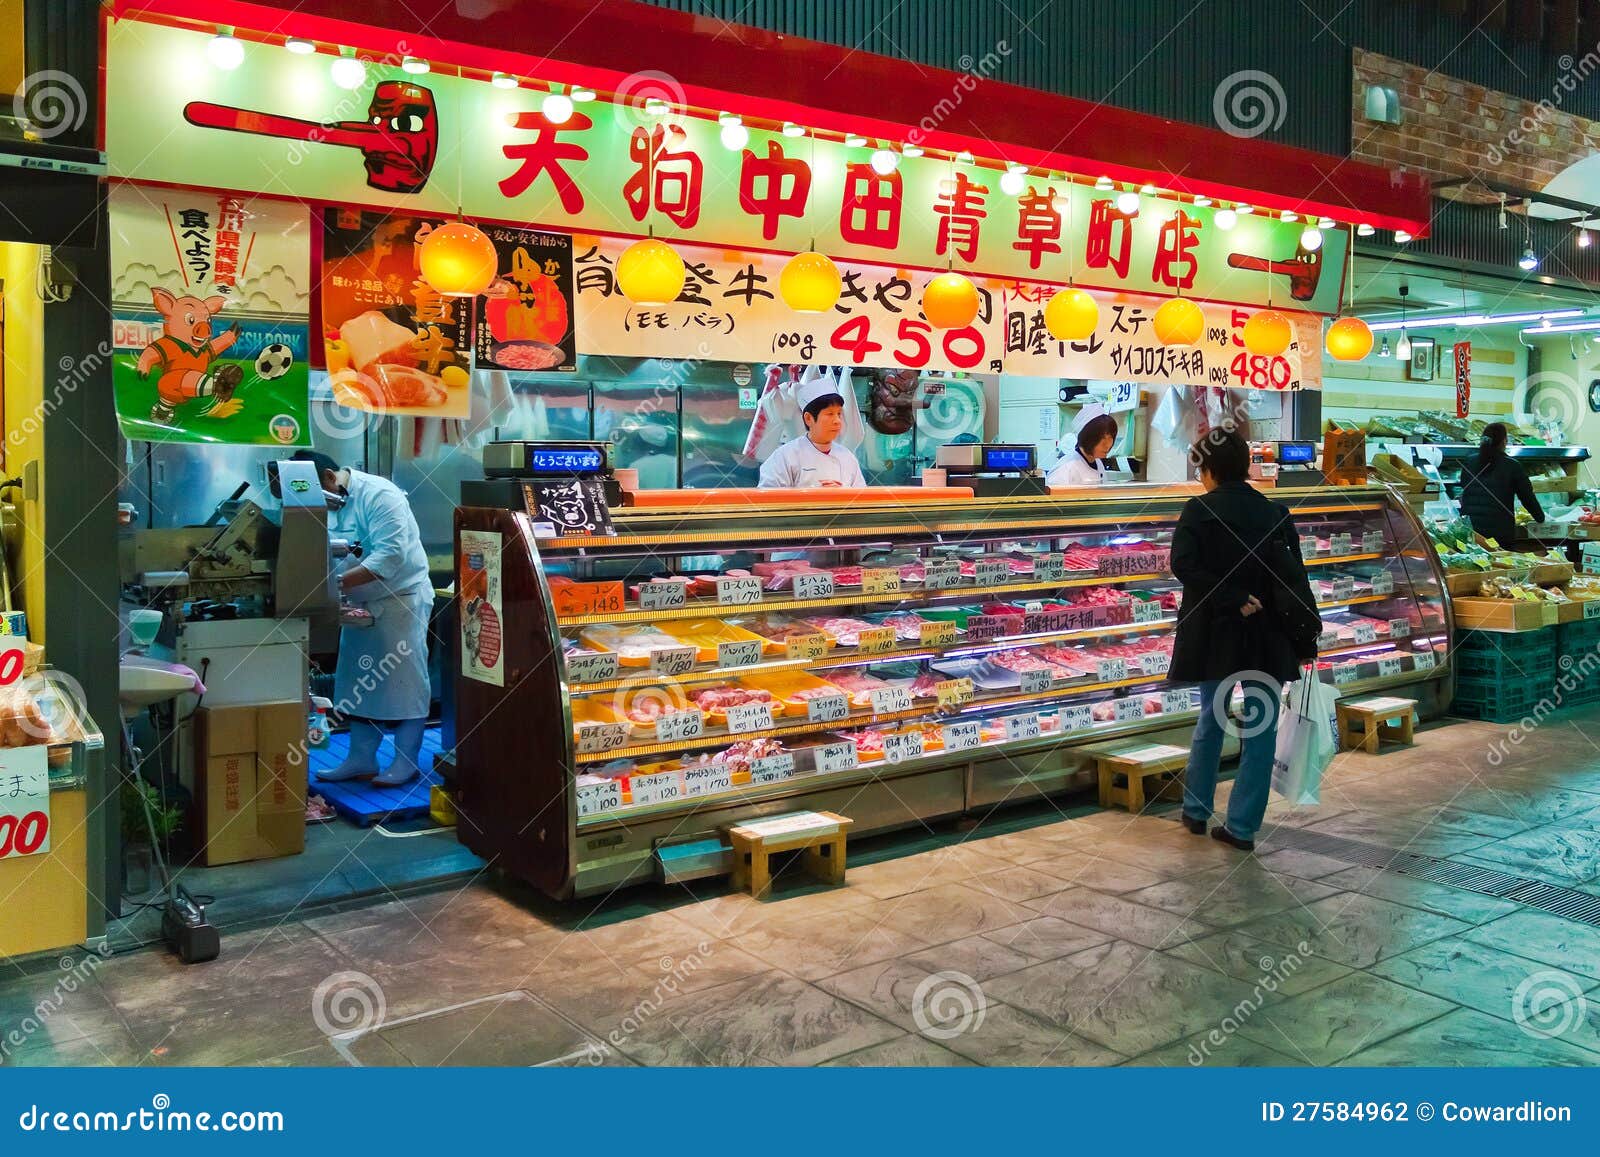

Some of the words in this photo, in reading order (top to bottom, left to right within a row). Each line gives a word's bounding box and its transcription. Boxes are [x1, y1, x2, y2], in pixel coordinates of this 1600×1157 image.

[498, 111, 1202, 290] 天狗中田青草町店
[772, 333, 817, 360] 100g
[830, 315, 986, 368] 450
[1207, 327, 1228, 346] 100g
[990, 360, 1003, 373] 円
[1110, 343, 1205, 378] サイコロステーキ用
[1208, 367, 1229, 385] 100g
[1230, 352, 1291, 390] 480
[814, 584, 832, 596] 330
[883, 581, 898, 590] 300
[592, 596, 619, 611] 148
[665, 595, 684, 605] 160
[741, 590, 760, 604] 170
[739, 653, 758, 665] 120
[807, 647, 823, 658] 300
[592, 667, 613, 679] 160
[670, 660, 692, 673] 180
[894, 698, 909, 709] 160
[831, 707, 846, 719] 100
[754, 716, 770, 729] 120
[682, 724, 699, 737] 60
[603, 736, 624, 749] 210
[963, 737, 979, 748] 160
[905, 745, 921, 757] 120
[709, 777, 729, 789] 170
[660, 786, 678, 799] 120
[600, 797, 618, 811] 100
